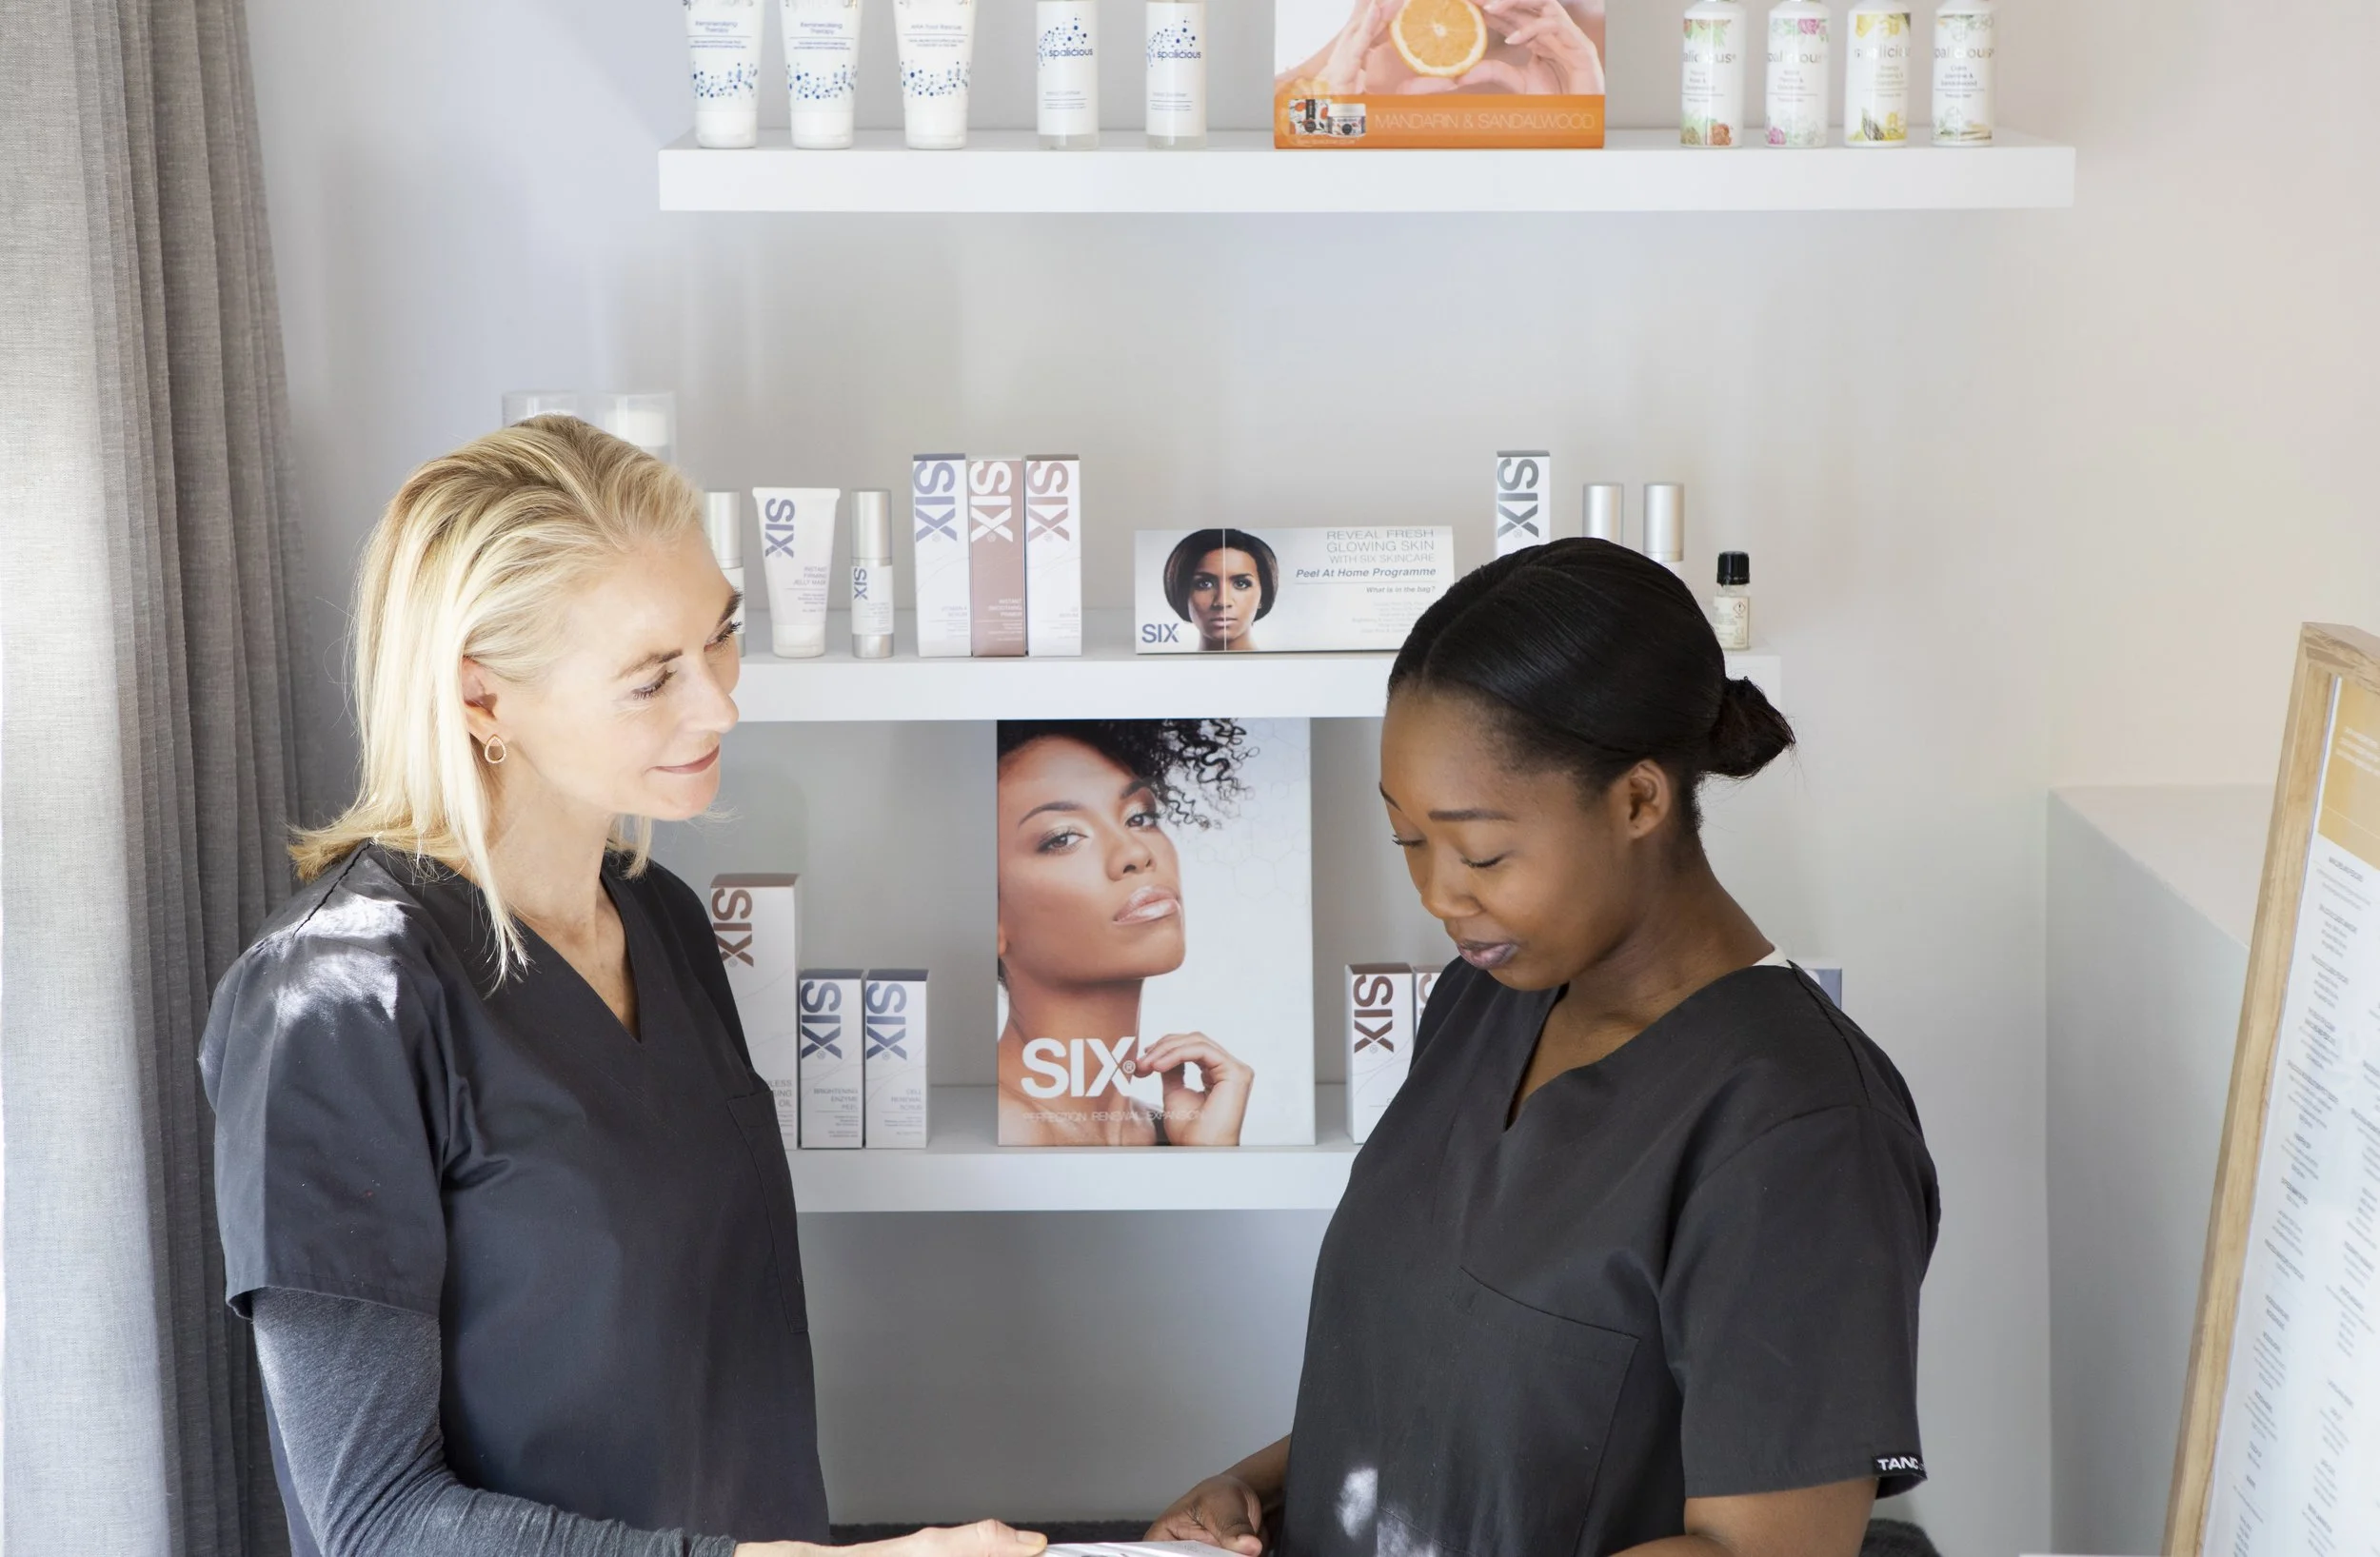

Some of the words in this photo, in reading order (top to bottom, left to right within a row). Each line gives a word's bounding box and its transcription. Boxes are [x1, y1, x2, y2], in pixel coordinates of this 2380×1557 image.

[1049, 47, 1093, 60] spalicious
[1157, 49, 1201, 61] spalicious
[1374, 113, 1457, 129] MANDARIN
[1464, 113, 1475, 128] &
[1478, 112, 1595, 129] SANDALWOOD
[764, 498, 796, 559] SIX
[913, 461, 957, 542] SIX
[969, 461, 1014, 542] SIX
[1026, 461, 1070, 542] SIX
[1497, 458, 1539, 539] SIX
[1326, 530, 1378, 541] REVEAL
[1386, 529, 1434, 539] FRESH
[1326, 541, 1397, 553] GLOWING
[1401, 540, 1435, 551] SKIN
[1329, 554, 1357, 563] WITH
[1359, 554, 1374, 563] SIX
[1379, 553, 1436, 562] SKINCARE
[853, 567, 868, 600] SIX
[1296, 569, 1319, 578] Peel
[1322, 569, 1335, 578] At
[1337, 568, 1370, 578] Home
[1372, 567, 1437, 579] Programme
[1141, 623, 1180, 643] SIX
[711, 888, 754, 968] SIX
[801, 980, 843, 1060] SIX
[865, 981, 907, 1060] SIX
[1353, 974, 1395, 1054] SIX
[1021, 1035, 1136, 1098] SIX
